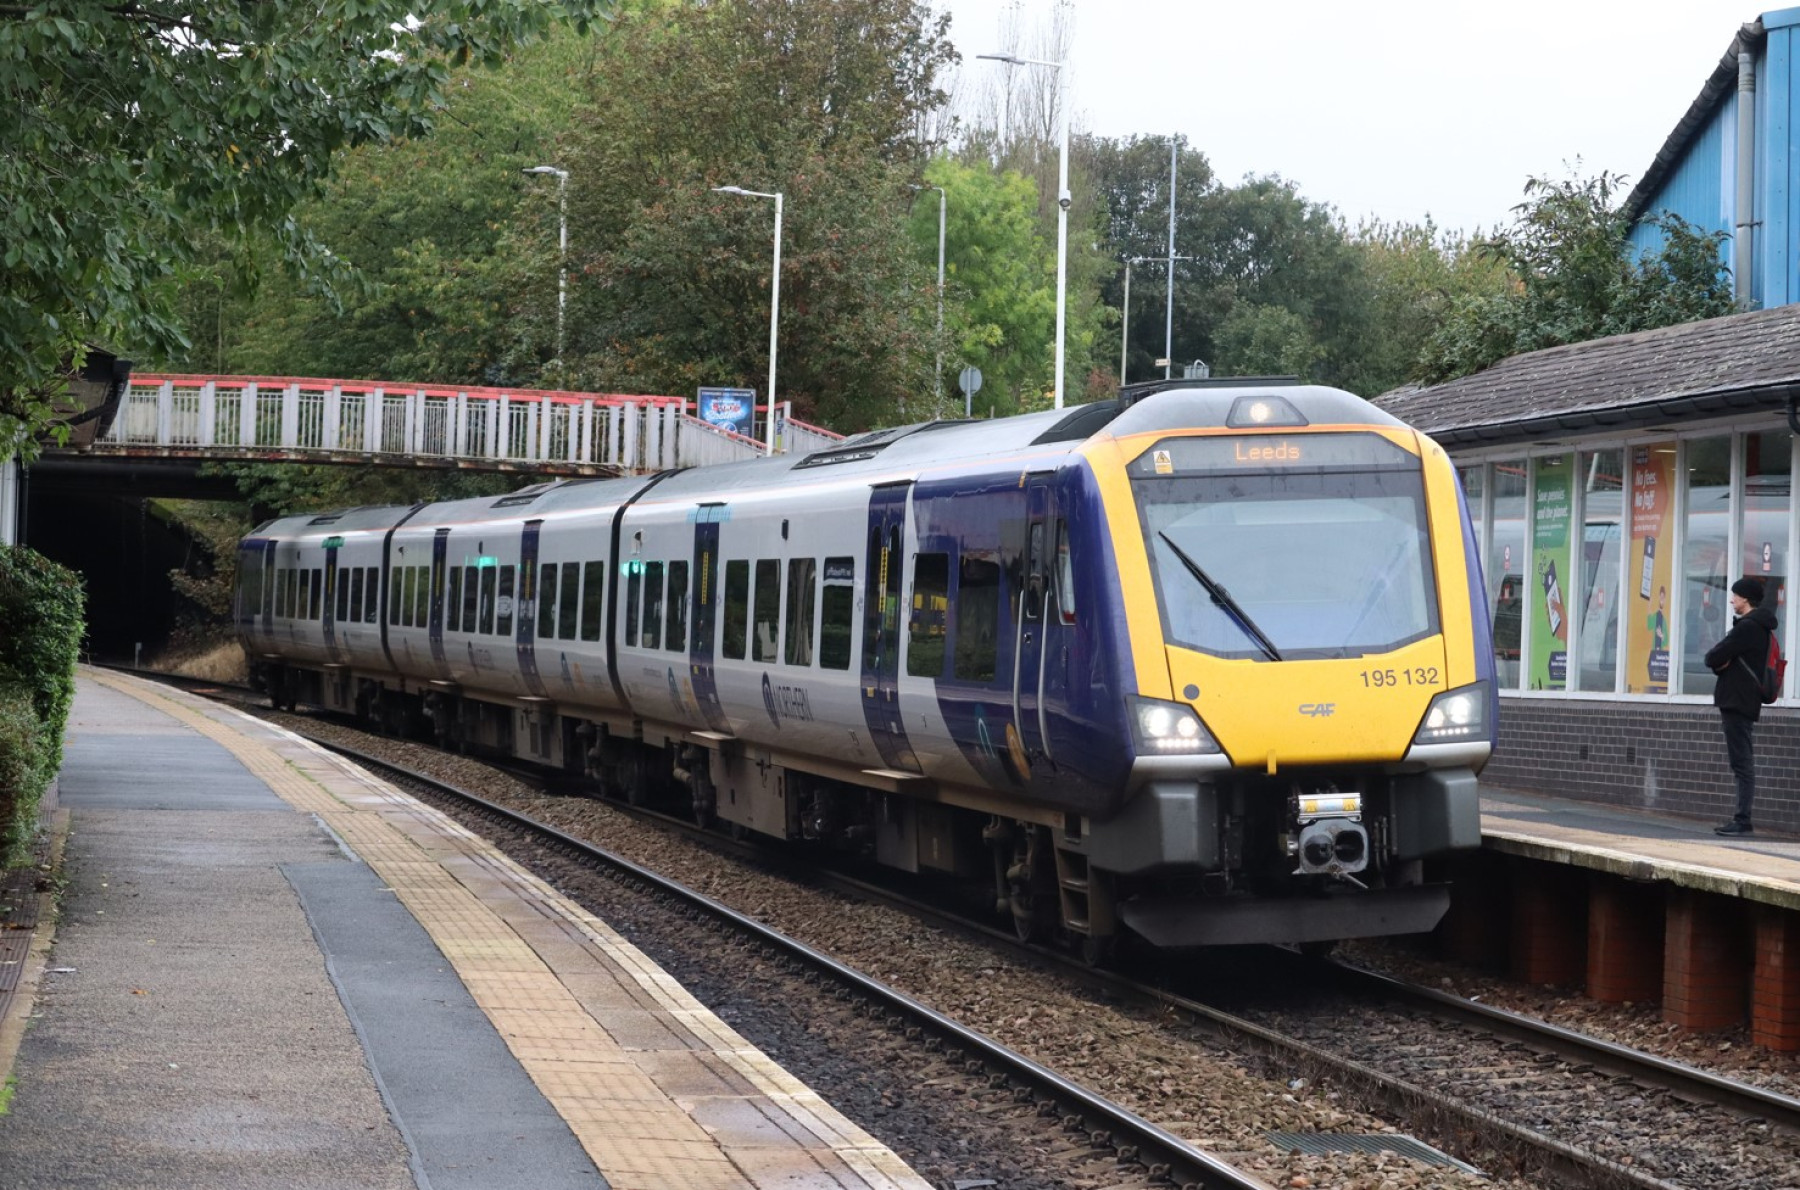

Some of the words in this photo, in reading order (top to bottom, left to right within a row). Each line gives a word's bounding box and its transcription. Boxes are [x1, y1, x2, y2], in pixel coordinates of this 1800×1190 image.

[1236, 441, 1300, 461] Leeds
[1635, 470, 1643, 486] No
[1634, 491, 1643, 507] No
[1360, 670, 1397, 687] 195
[1403, 667, 1439, 685] 132
[1299, 703, 1335, 717] CAF
